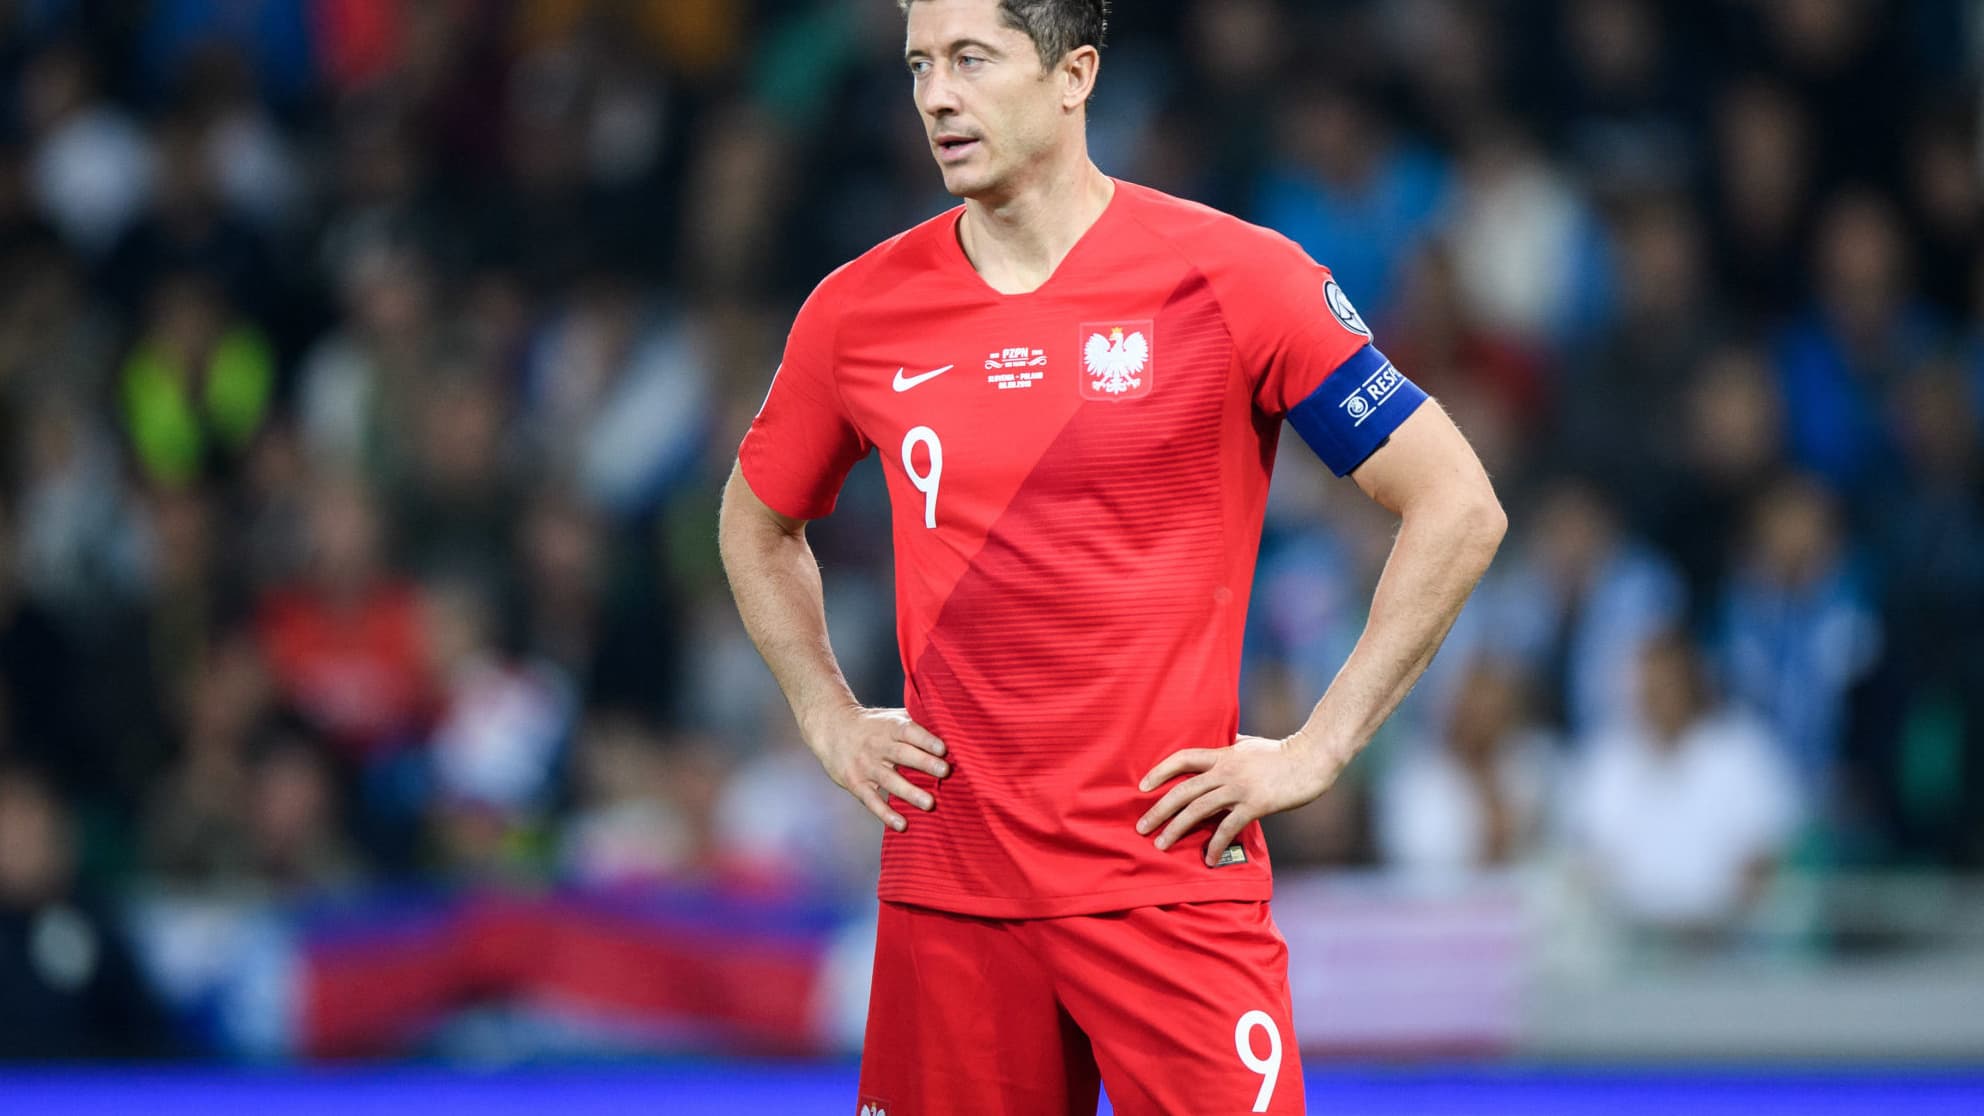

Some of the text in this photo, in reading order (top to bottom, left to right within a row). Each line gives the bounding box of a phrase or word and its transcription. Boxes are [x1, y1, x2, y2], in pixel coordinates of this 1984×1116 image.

[1002, 347, 1029, 359] PZPN
[901, 425, 943, 529] 9
[1234, 1009, 1283, 1113] 9
